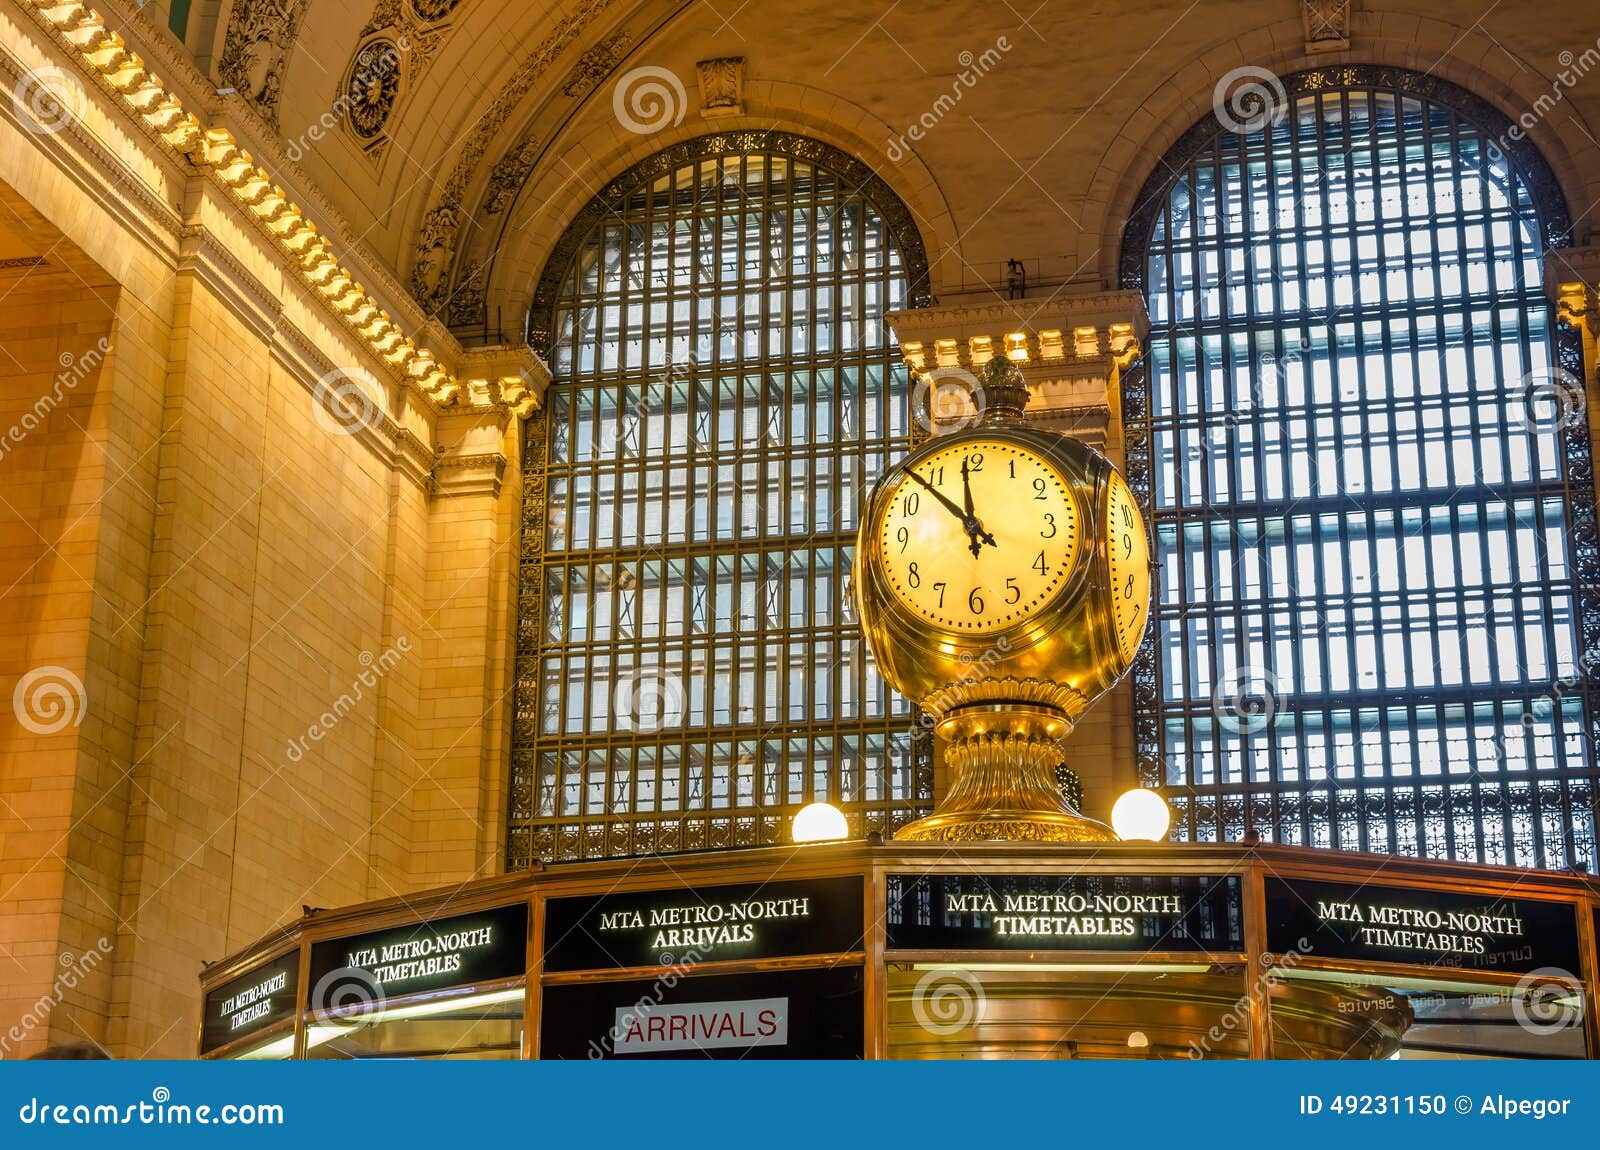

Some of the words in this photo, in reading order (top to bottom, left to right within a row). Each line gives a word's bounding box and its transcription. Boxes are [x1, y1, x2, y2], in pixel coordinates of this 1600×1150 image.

[929, 466, 944, 487] 11
[1009, 459, 1016, 478] 1
[1033, 478, 1048, 500] 2
[903, 492, 919, 517] 10
[1121, 504, 1135, 529] 10
[1040, 513, 1057, 538] 3
[897, 527, 909, 554] 9
[1123, 533, 1132, 560] 9
[908, 562, 920, 588] 8
[1032, 549, 1050, 576] 4
[933, 582, 946, 608] 7
[1005, 577, 1021, 604] 5
[1124, 574, 1135, 599] 8
[969, 587, 985, 614] 6
[600, 912, 644, 930] MTA
[649, 898, 809, 926] METRO-NORTH
[947, 894, 998, 913] MTA
[1004, 894, 1181, 914] METRO-NORTH
[994, 915, 1135, 936] TIMETABLES
[1317, 901, 1364, 923] MTA
[1368, 906, 1523, 936] METRO-NORTH
[347, 950, 378, 969] MTA
[381, 927, 492, 962] METRO-NORTH
[652, 924, 755, 948] ARRIVALS
[1361, 927, 1485, 954] TIMETABLES
[374, 953, 461, 985] TIMETABLES
[221, 997, 235, 1017] MTA
[236, 972, 286, 1010] METRO-NORTH
[231, 998, 271, 1030] TIMETABLES
[625, 1010, 778, 1043] ARRIVALS
